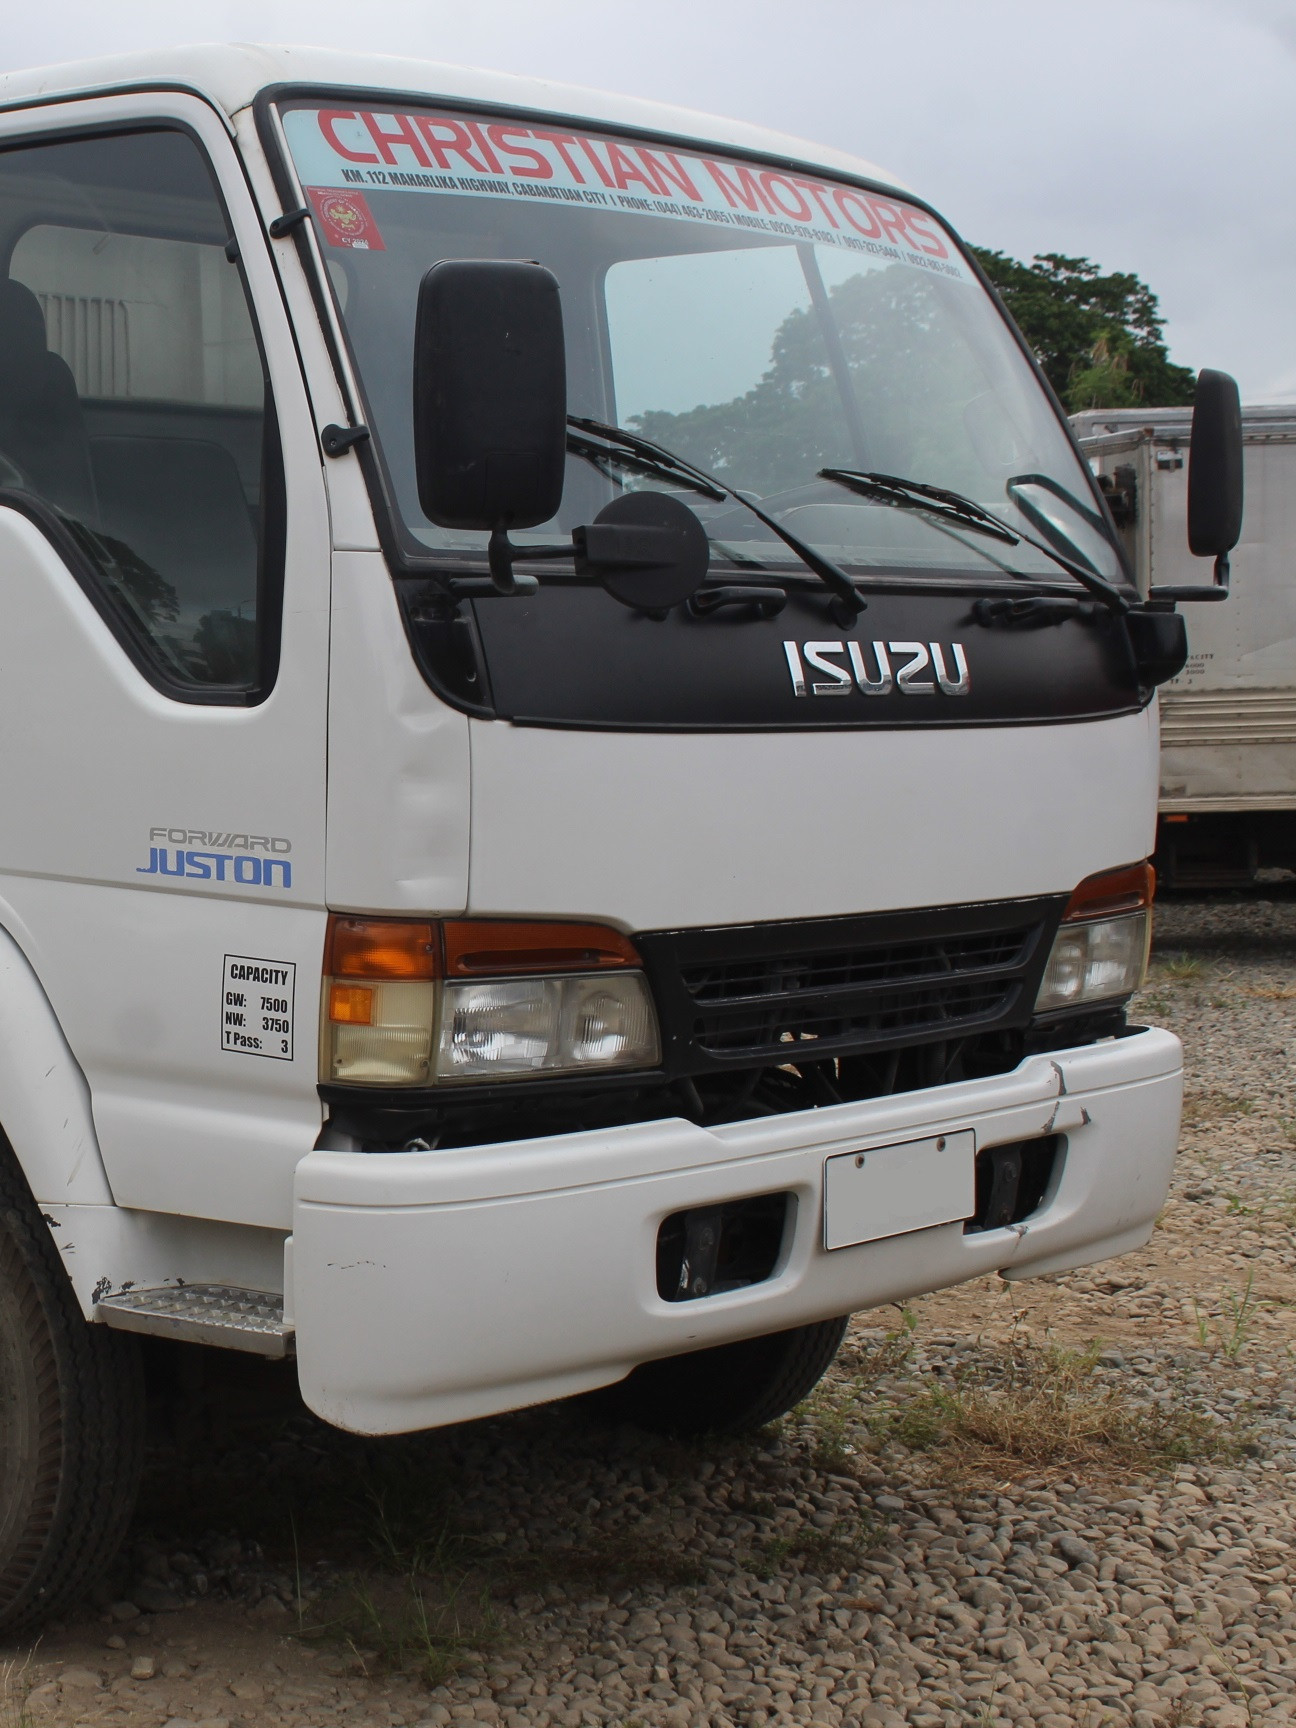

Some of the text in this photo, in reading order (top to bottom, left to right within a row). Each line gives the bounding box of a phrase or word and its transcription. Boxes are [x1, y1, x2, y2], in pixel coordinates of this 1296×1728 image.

[317, 110, 949, 260] CHRISTIAN MOTORS
[341, 169, 368, 183] KM.
[366, 171, 389, 185] 112
[388, 172, 459, 190] MAHARLIKA
[454, 177, 515, 196] HIGHWAY,
[512, 182, 585, 202] CABANATUAN
[582, 191, 608, 205] CITY
[783, 641, 971, 697] ISUZU
[149, 827, 292, 854] FORWARD
[230, 963, 288, 986] CAPACITY
[225, 991, 287, 1013] GW: 7500
[225, 1011, 289, 1034] NW: 3750
[225, 1031, 288, 1053] T Pass: 3
